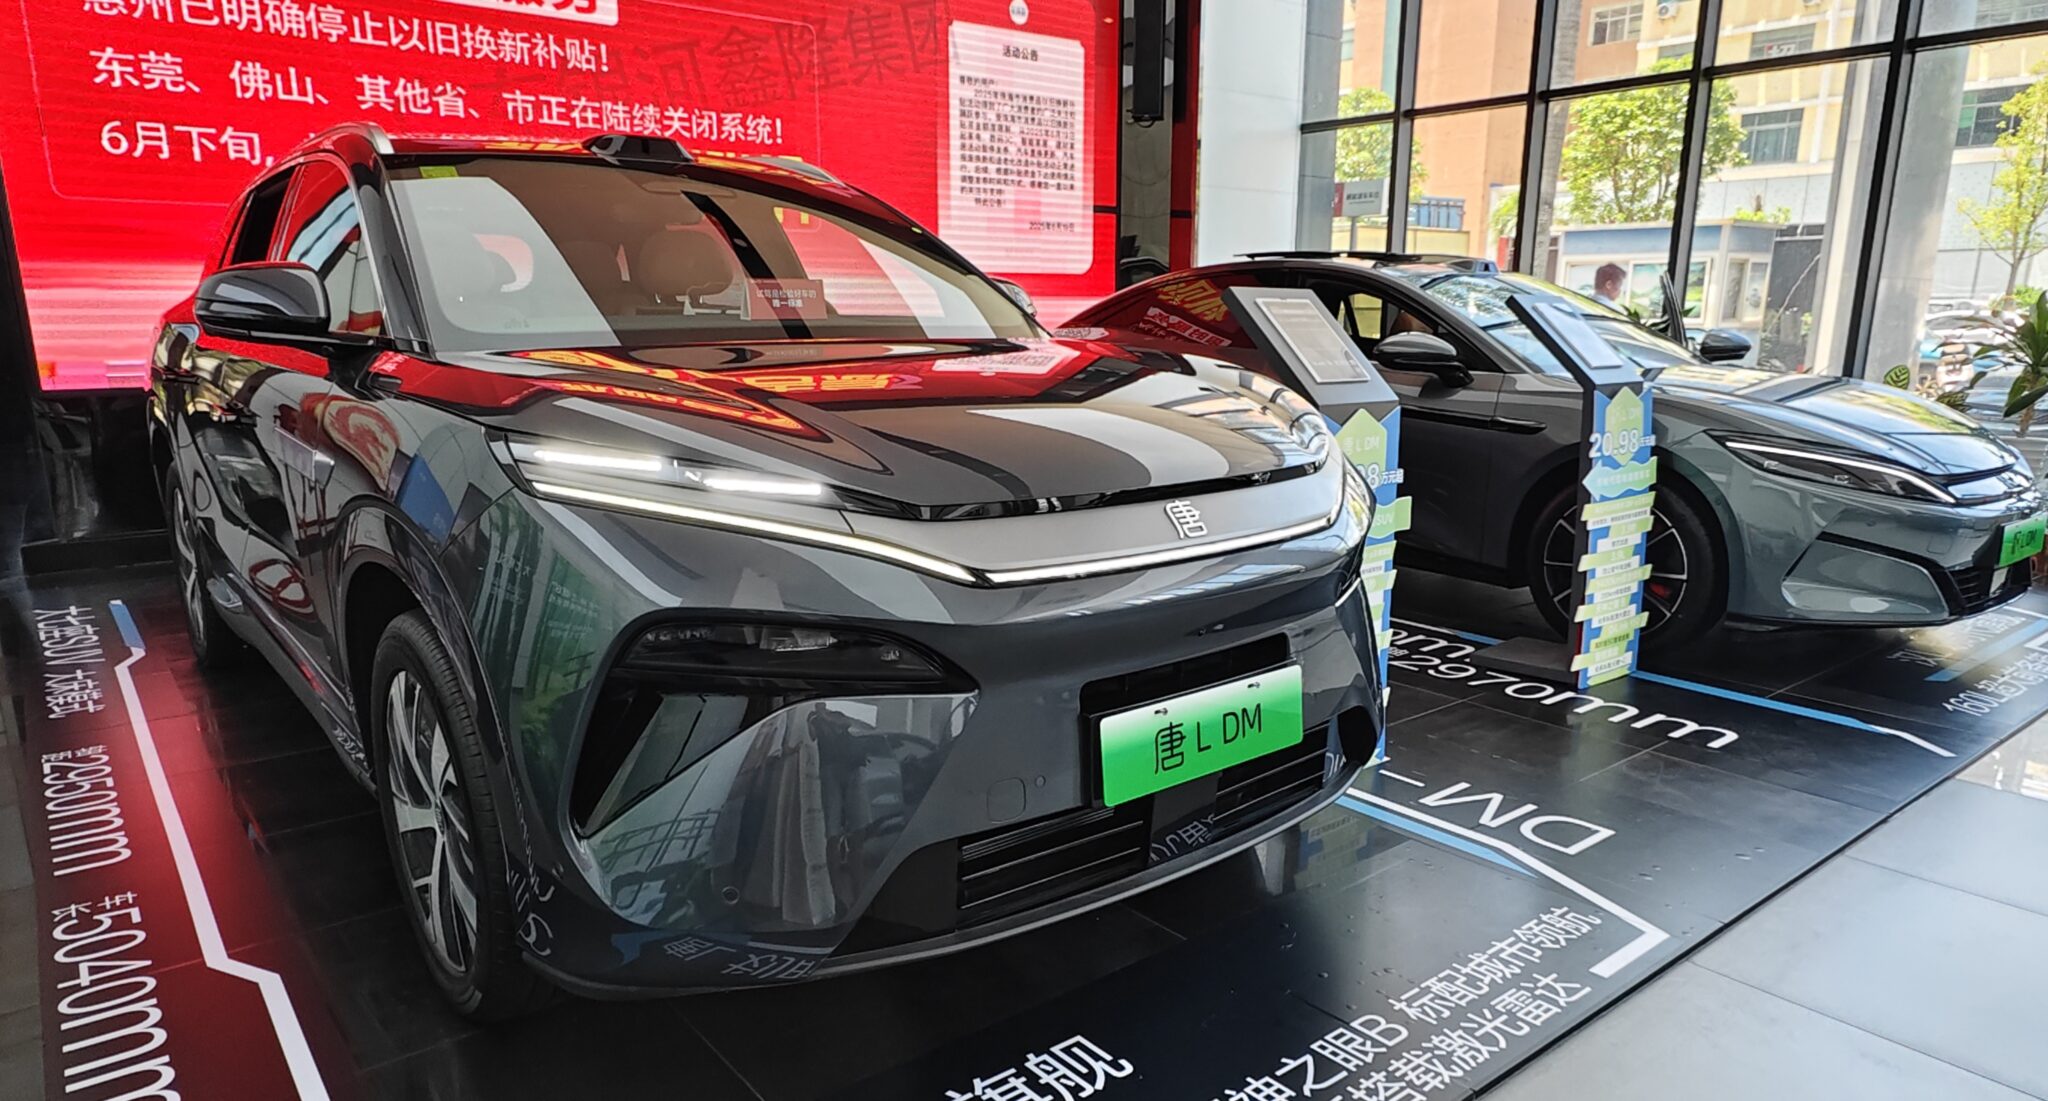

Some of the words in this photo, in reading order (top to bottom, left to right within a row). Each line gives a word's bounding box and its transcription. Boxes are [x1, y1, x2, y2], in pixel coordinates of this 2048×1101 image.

[1002, 44, 1039, 62] 活动公告
[1222, 702, 1263, 745] DM
